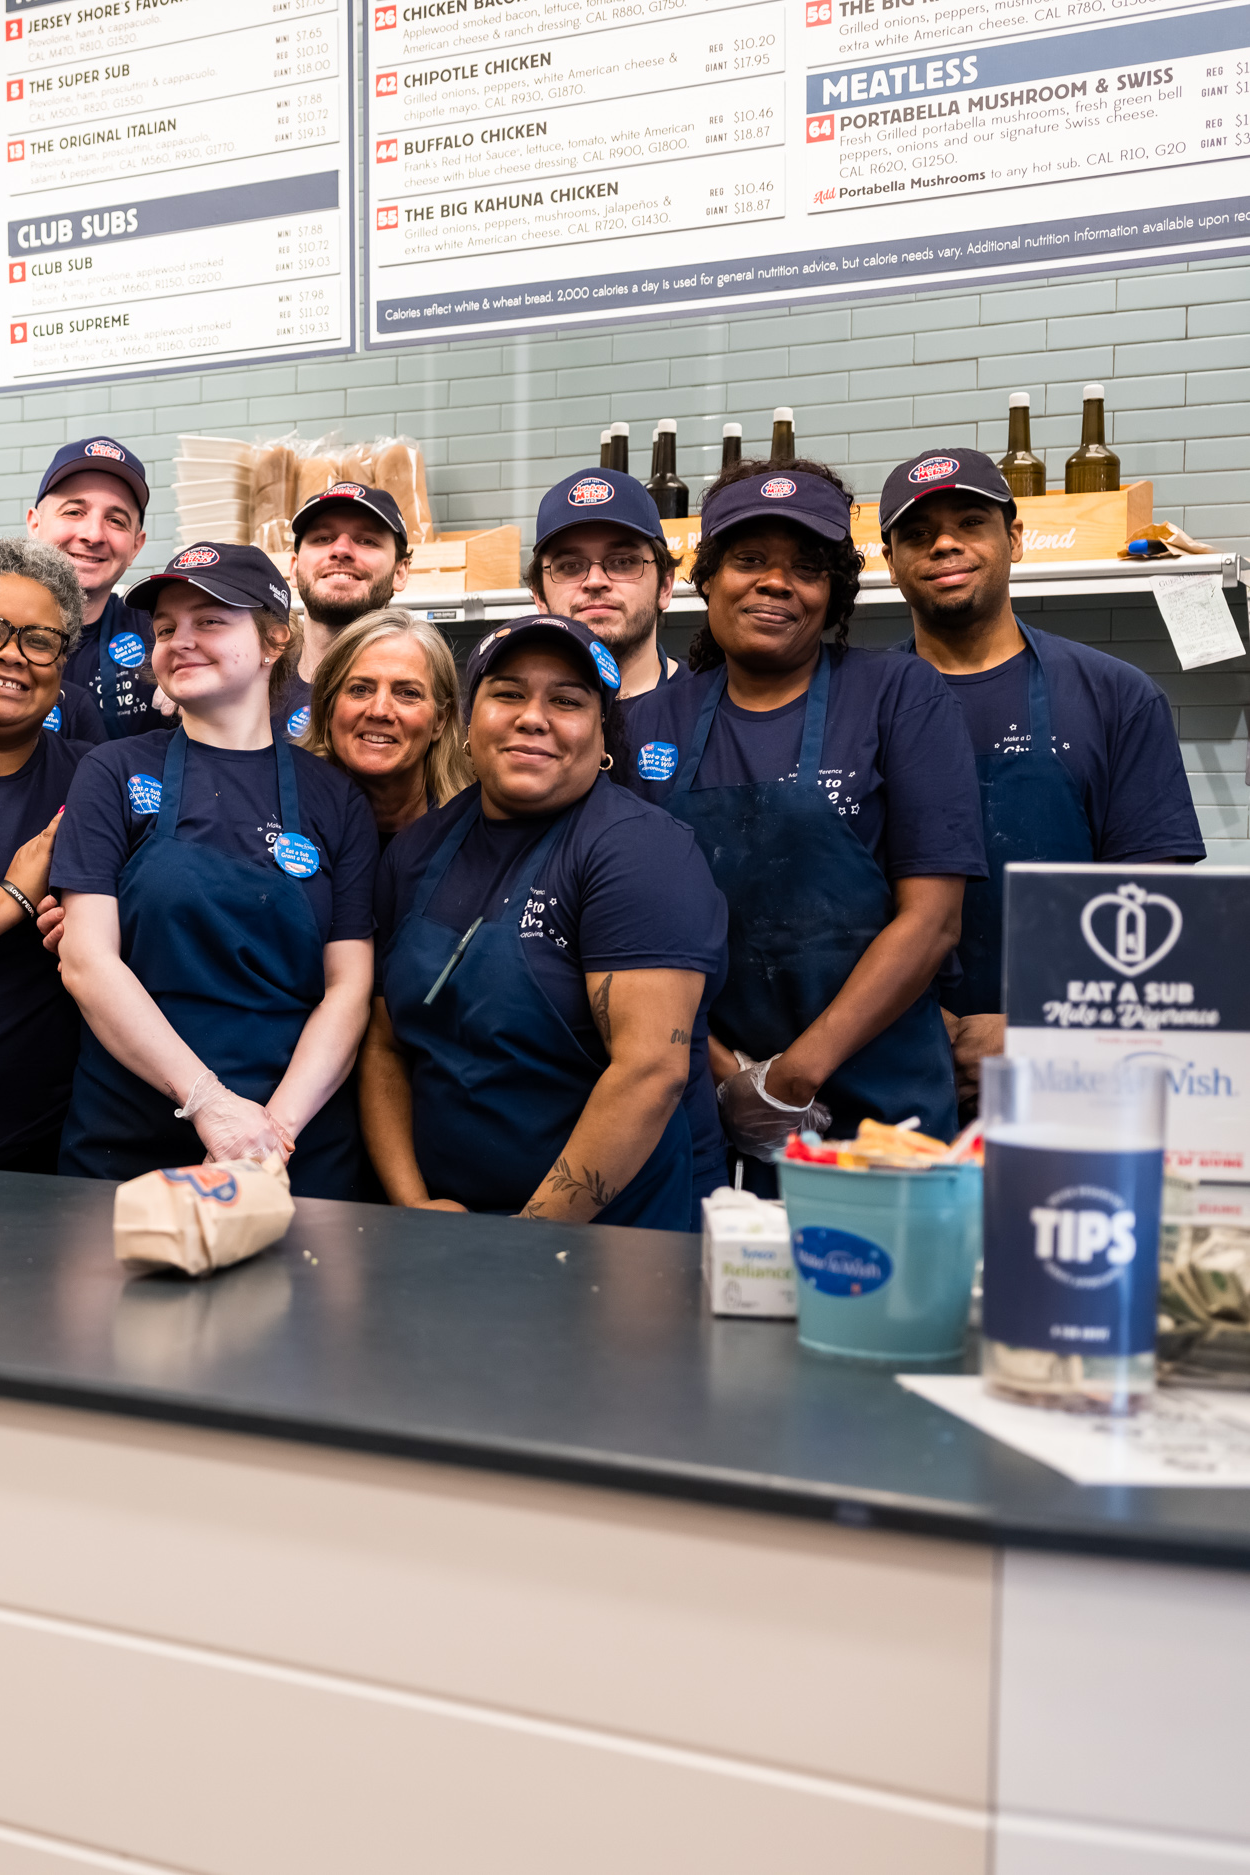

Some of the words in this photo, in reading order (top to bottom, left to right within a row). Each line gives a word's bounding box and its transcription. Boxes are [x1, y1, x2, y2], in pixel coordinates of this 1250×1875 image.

[27, 12, 73, 34] JERSEY
[76, 1, 132, 25] SHORE'S
[375, 9, 397, 28] 26
[402, 0, 468, 22] CHICKEN
[28, 78, 54, 95] THE
[57, 69, 101, 90] SUPER
[104, 63, 131, 80] SUB
[376, 76, 398, 94] 42
[403, 64, 479, 89] CHIPOTLE
[484, 51, 552, 76] CHICKEN
[821, 55, 979, 106] MEATLESS
[807, 119, 833, 140] 64
[839, 100, 961, 132] PORTABELLA
[967, 80, 1088, 114] MUSHROOM
[1094, 77, 1110, 94] &
[1116, 66, 1175, 91] SWISS
[9, 143, 24, 160] 13
[30, 139, 55, 155] THE
[59, 128, 122, 151] ORIGINAL
[126, 117, 178, 139] ITALIAN
[376, 143, 398, 161] 44
[404, 133, 474, 156] BUFFALO
[480, 120, 548, 145] CHICKEN
[377, 210, 398, 228] 55
[405, 205, 434, 223] THE
[440, 201, 468, 218] BIG
[474, 191, 544, 215] KAHUNA
[550, 180, 619, 204] CHICKEN
[813, 186, 837, 206] Add
[839, 179, 907, 200] Portabella
[910, 168, 986, 191] Mushrooms
[16, 218, 74, 249] CLUB
[81, 207, 139, 240] SUBS
[31, 260, 63, 277] CLUB
[67, 256, 94, 272] SUB
[385, 307, 420, 321] Calories
[424, 303, 451, 317] reflect
[455, 300, 479, 313] white
[482, 298, 490, 310] &
[493, 295, 522, 309] wheat
[525, 291, 553, 305] bread.
[557, 286, 589, 302] 2,000
[593, 284, 628, 298] calories
[632, 284, 638, 294] a
[642, 279, 659, 294] day
[663, 279, 669, 290] is
[674, 274, 696, 289] used
[700, 272, 713, 286] for
[717, 268, 754, 287] general
[758, 265, 798, 279] nutrition
[803, 260, 838, 274] advice,
[843, 256, 859, 270] but
[863, 252, 897, 267] calorie
[902, 247, 933, 263] needs
[938, 247, 962, 259] vary.
[967, 235, 1020, 255] Additional
[1025, 233, 1069, 248] nutrition
[1075, 224, 1138, 242] information
[1143, 215, 1193, 233] available
[1199, 214, 1229, 229] upon
[32, 321, 64, 338] CLUB
[68, 313, 130, 333] SUPREME
[915, 460, 954, 475] Jersey
[573, 483, 609, 495] Jersey
[824, 777, 842, 789] to
[9, 886, 24, 902] LOVE
[1066, 980, 1117, 1003] EAT
[1117, 981, 1140, 1003] A
[1144, 981, 1195, 1005] SUB
[1029, 1206, 1137, 1266] TIPS
